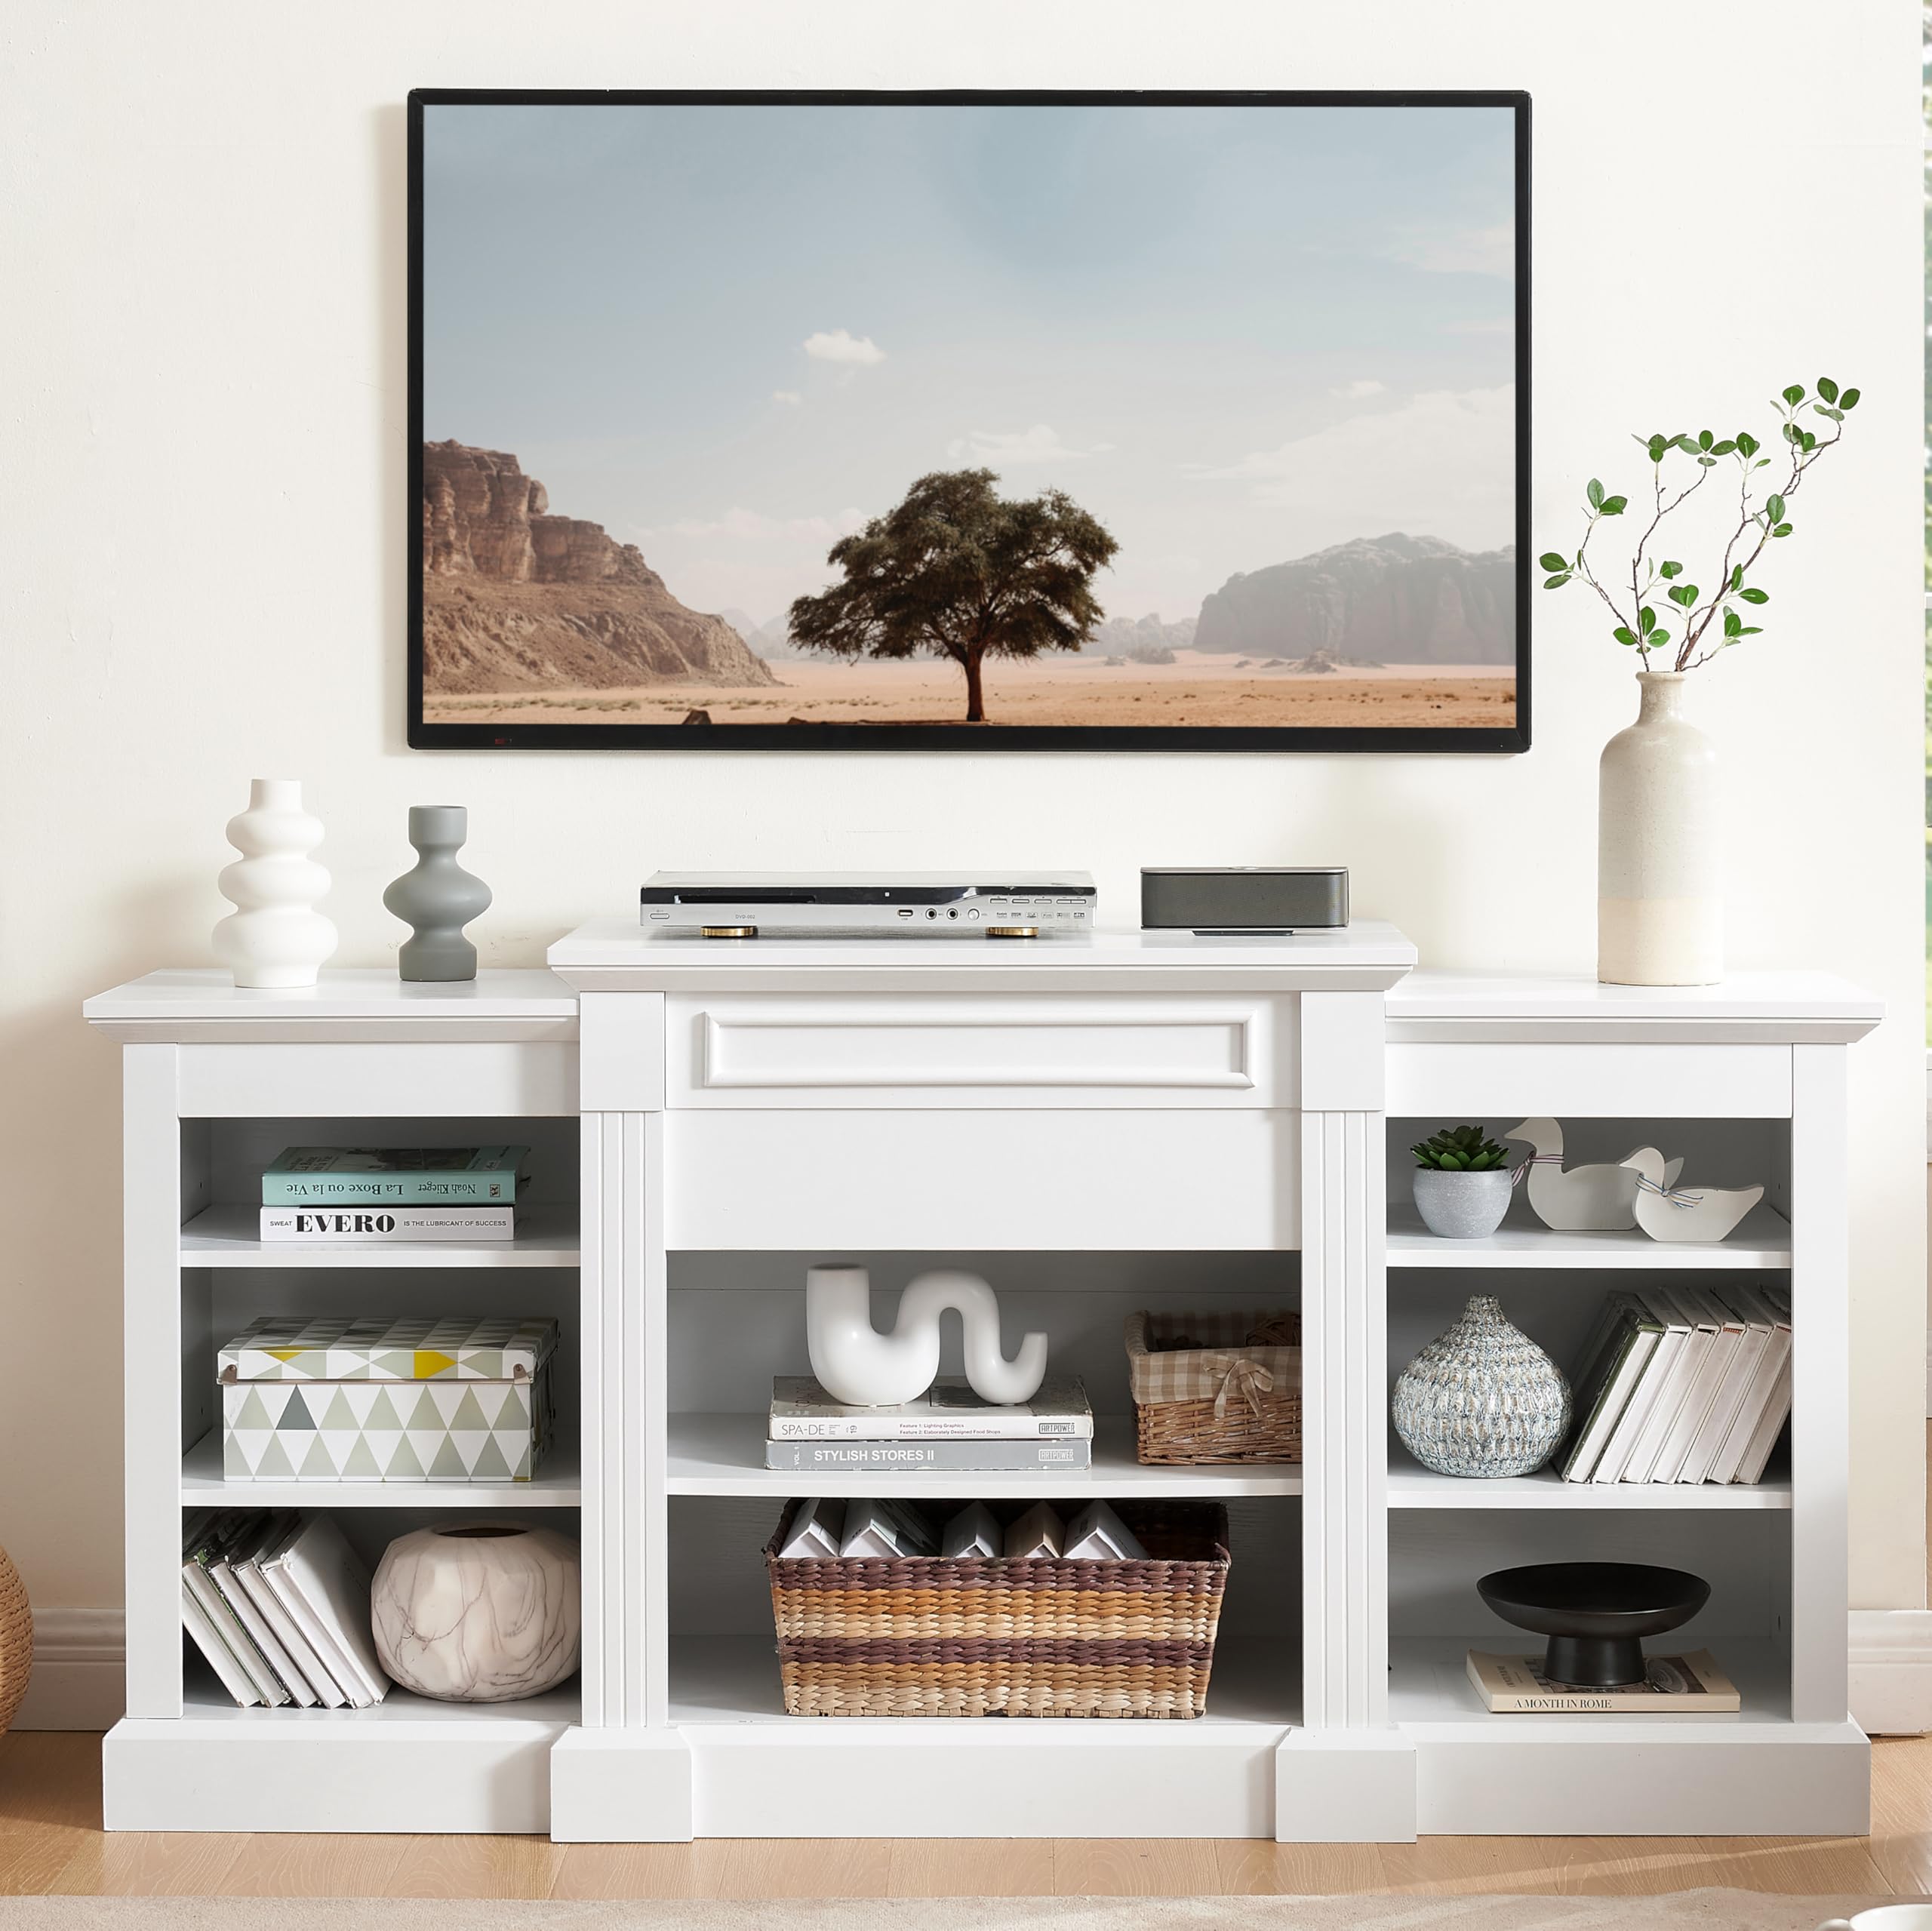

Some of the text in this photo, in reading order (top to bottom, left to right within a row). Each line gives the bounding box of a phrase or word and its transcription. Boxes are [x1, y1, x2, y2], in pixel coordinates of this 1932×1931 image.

[286, 1184, 309, 1195] Vie
[312, 1184, 325, 1195] la
[348, 1184, 383, 1195] Boxe
[386, 1184, 404, 1195] La
[417, 1182, 477, 1195] Noah Klieger
[294, 1214, 395, 1233] EVERO
[781, 1424, 825, 1435] SPA-DE
[1041, 1423, 1075, 1432] ARTPOWER
[814, 1450, 934, 1461] STYLISH STORES II
[1041, 1450, 1074, 1460] ARTPOWER
[1514, 1699, 1612, 1708] A MONTH IN ROME
